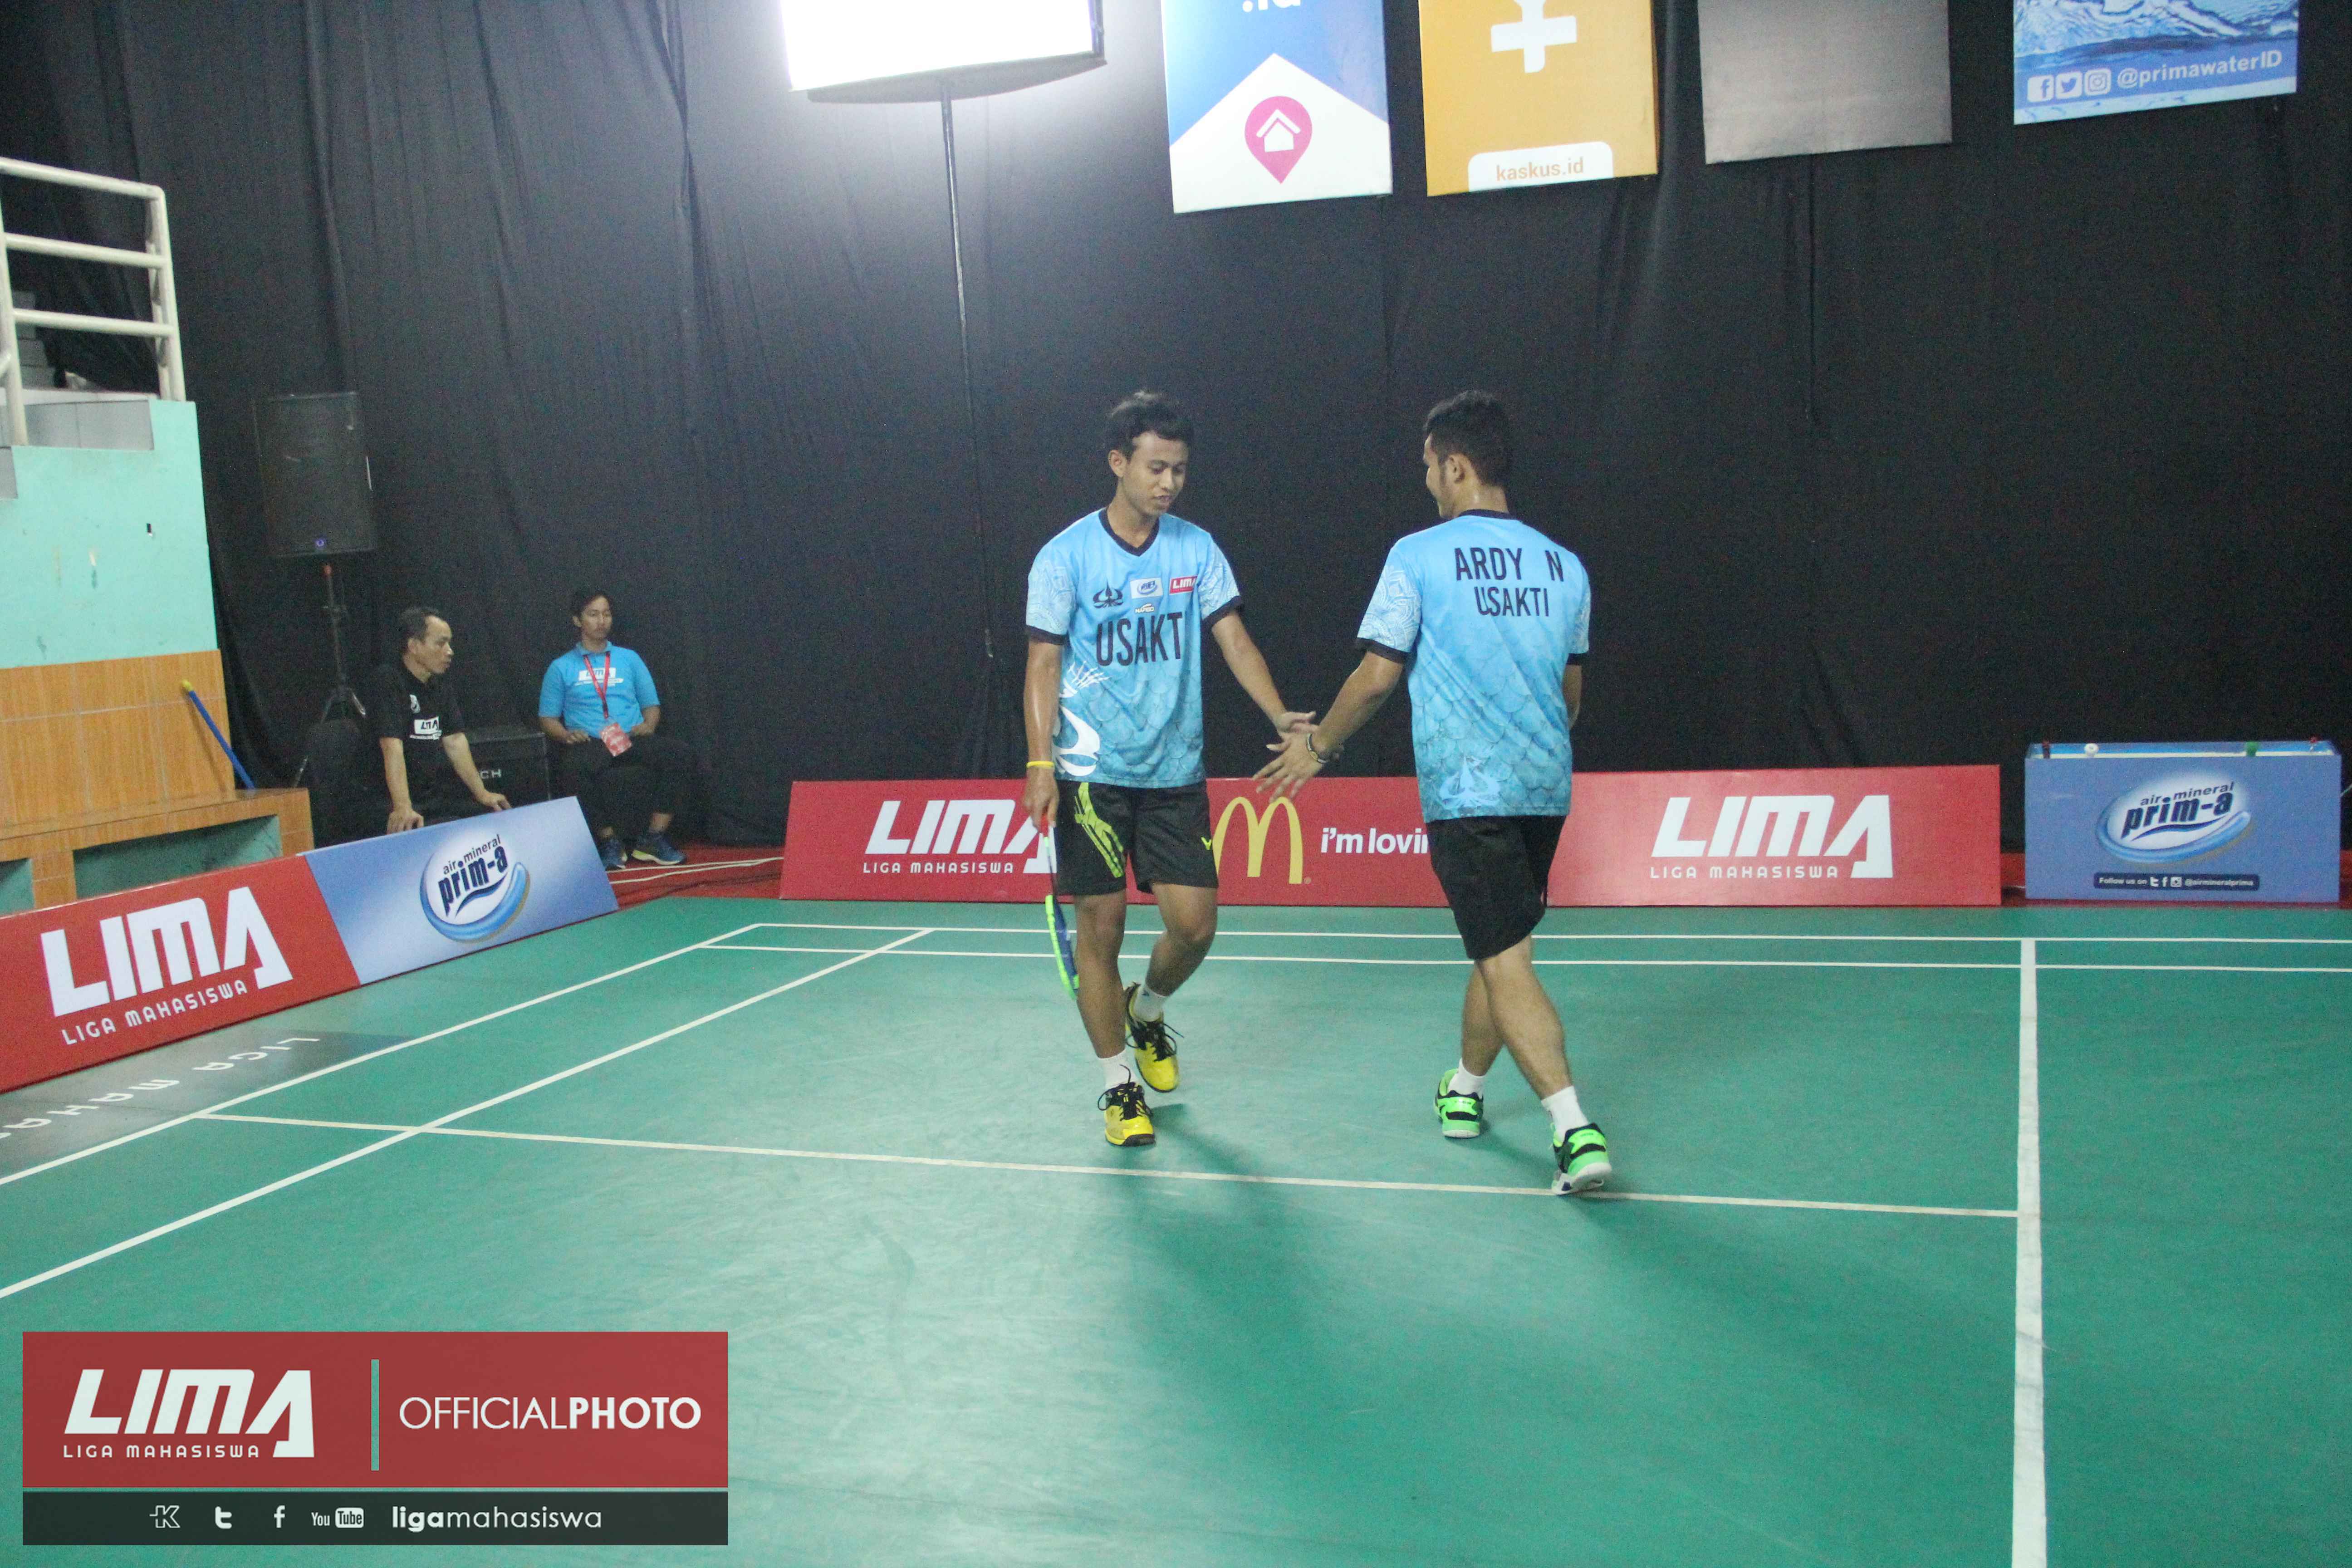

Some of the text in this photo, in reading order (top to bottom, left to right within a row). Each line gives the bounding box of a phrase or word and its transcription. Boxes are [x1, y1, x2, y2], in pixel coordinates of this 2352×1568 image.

[2117, 50, 2282, 89] @primawaterID
[1496, 157, 1583, 181] kaskus.id
[1455, 548, 1564, 582] ARDY N
[1474, 586, 1549, 617] USAKTI
[2140, 781, 2234, 806] air mineral
[2121, 792, 2233, 839] prim-a
[443, 834, 501, 875] air mineral
[865, 799, 1057, 874] LIMA
[1651, 795, 1893, 878] LIMA
[438, 846, 508, 917] prim-a
[863, 862, 1014, 874] LIGA MAHASISWA
[1650, 866, 1838, 878] LIGA MAHASISWA
[2099, 877, 2124, 885] Follow
[40, 886, 294, 1017] LIMA
[61, 979, 248, 1045] LIGA MAHASISWA
[193, 1037, 320, 1071] LIGA
